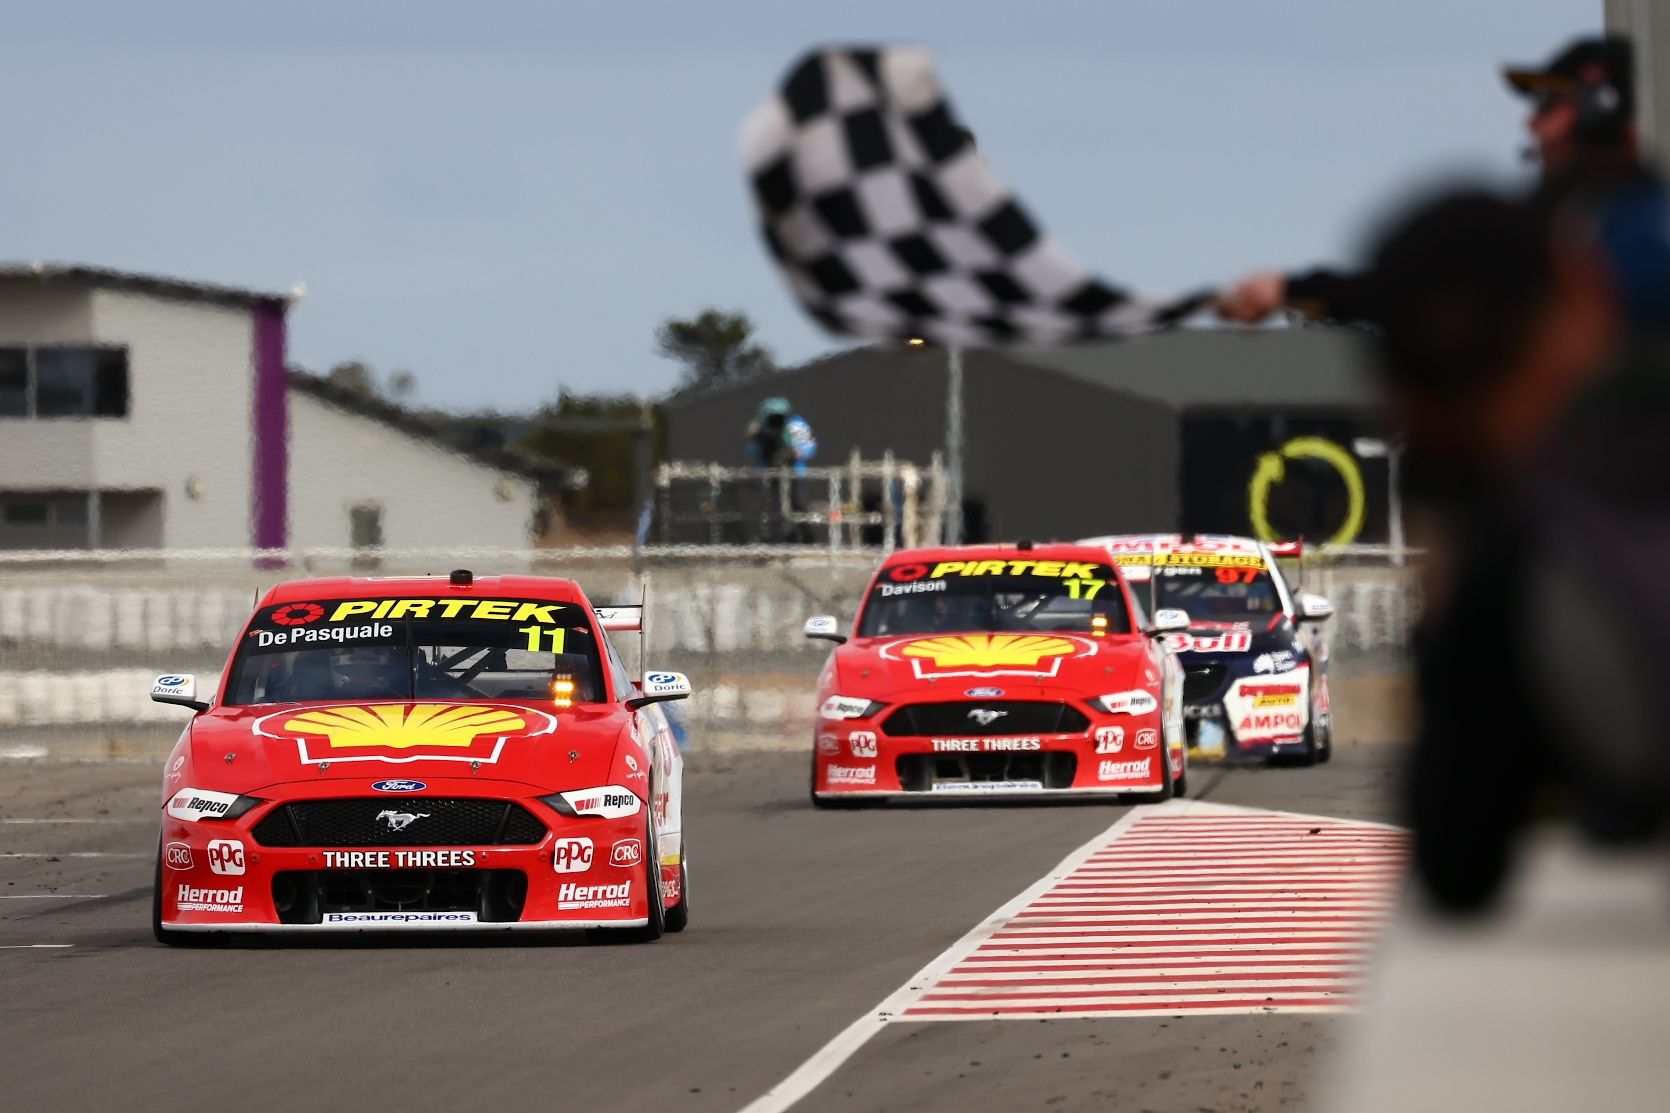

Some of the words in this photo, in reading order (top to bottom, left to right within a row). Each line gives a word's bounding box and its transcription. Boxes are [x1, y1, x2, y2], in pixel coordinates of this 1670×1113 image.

[1167, 553, 1262, 568] STORAGE
[930, 560, 1099, 579] PIRTEK
[1215, 567, 1259, 584] 97
[881, 580, 947, 597] Davison
[1063, 580, 1106, 600] 17
[329, 600, 566, 624] PIRTEK
[258, 631, 287, 647] De
[291, 622, 393, 643] Pasquale
[519, 626, 565, 654] 11
[152, 686, 184, 695] Doric
[654, 683, 687, 691] Doric
[930, 740, 980, 752] THREE
[981, 738, 1041, 751] THREES
[1098, 757, 1152, 775] Herrod
[382, 780, 416, 791] Ford
[187, 797, 229, 813] Repco
[603, 795, 635, 808] Repco
[167, 848, 190, 863] CRC
[208, 843, 243, 871] PPG
[322, 852, 391, 868] THREE
[394, 850, 476, 867] THREES
[556, 841, 593, 870] PPG
[613, 844, 640, 861] CRC
[177, 884, 244, 904] Herrod
[557, 880, 632, 902] Herrod
[190, 903, 244, 913] PERFORMANCE
[578, 898, 631, 909] PERFORMANCE
[328, 912, 472, 923] Beaurepaires
